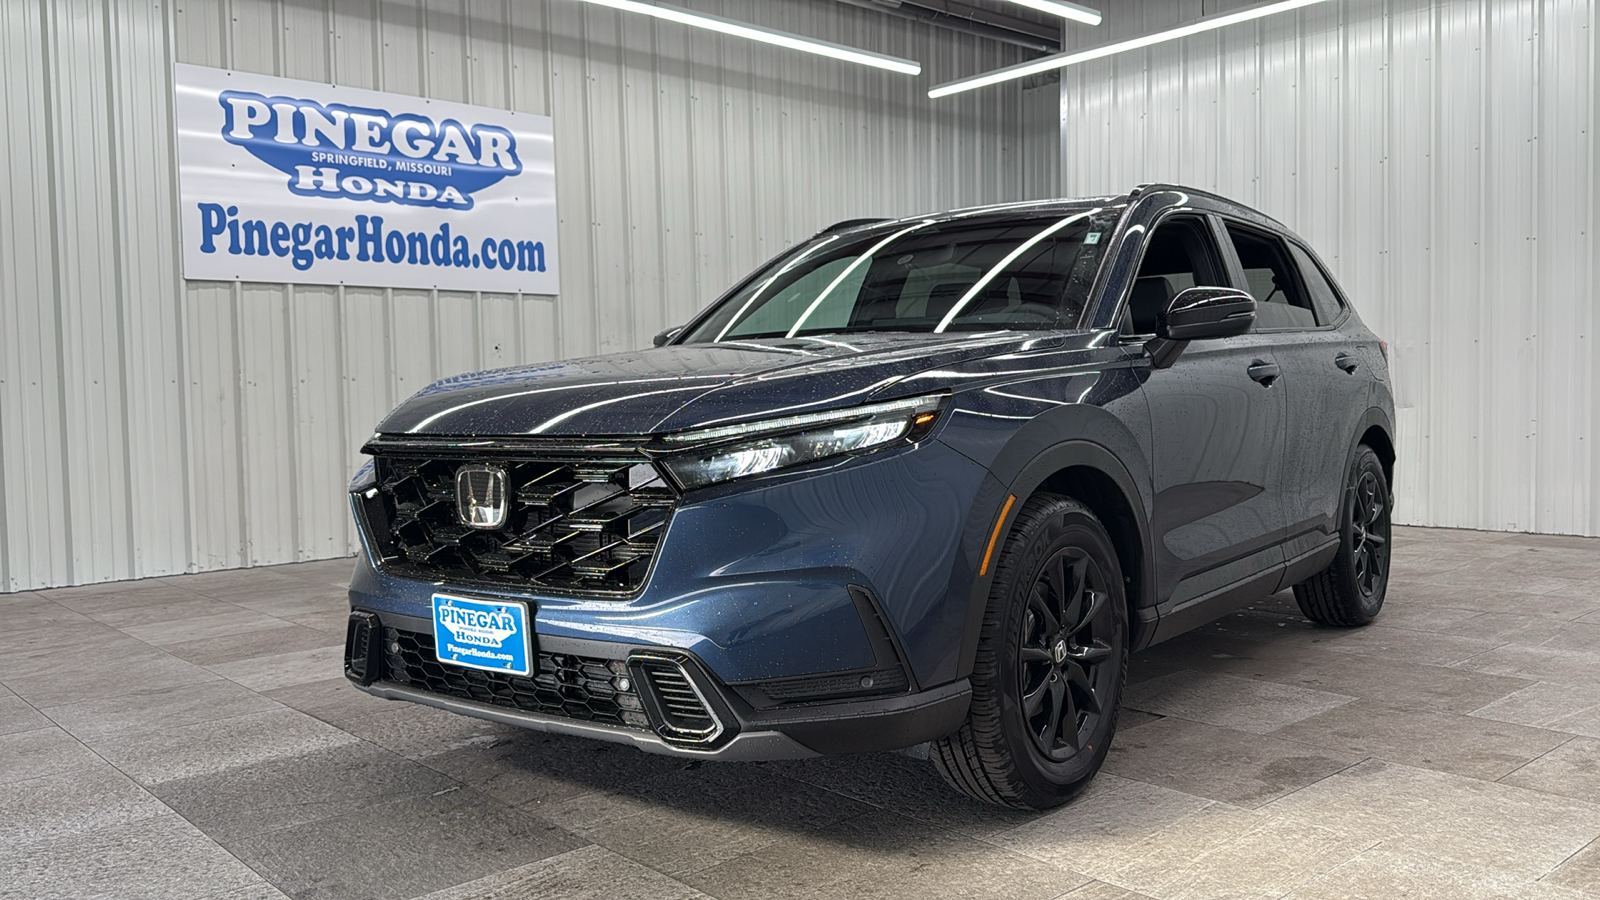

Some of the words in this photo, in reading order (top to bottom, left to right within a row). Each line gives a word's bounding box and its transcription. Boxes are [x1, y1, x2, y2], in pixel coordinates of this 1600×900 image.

[227, 97, 517, 170] PINEGAR
[310, 151, 392, 172] SPRINGFIELD,
[396, 160, 453, 177] MISSOURI
[295, 165, 469, 204] HONDA
[198, 202, 547, 272] PinegarHonda.com
[441, 608, 514, 631] PINEGAR
[456, 630, 499, 646] HONDA
[447, 643, 514, 661] PinegarHonda.com
